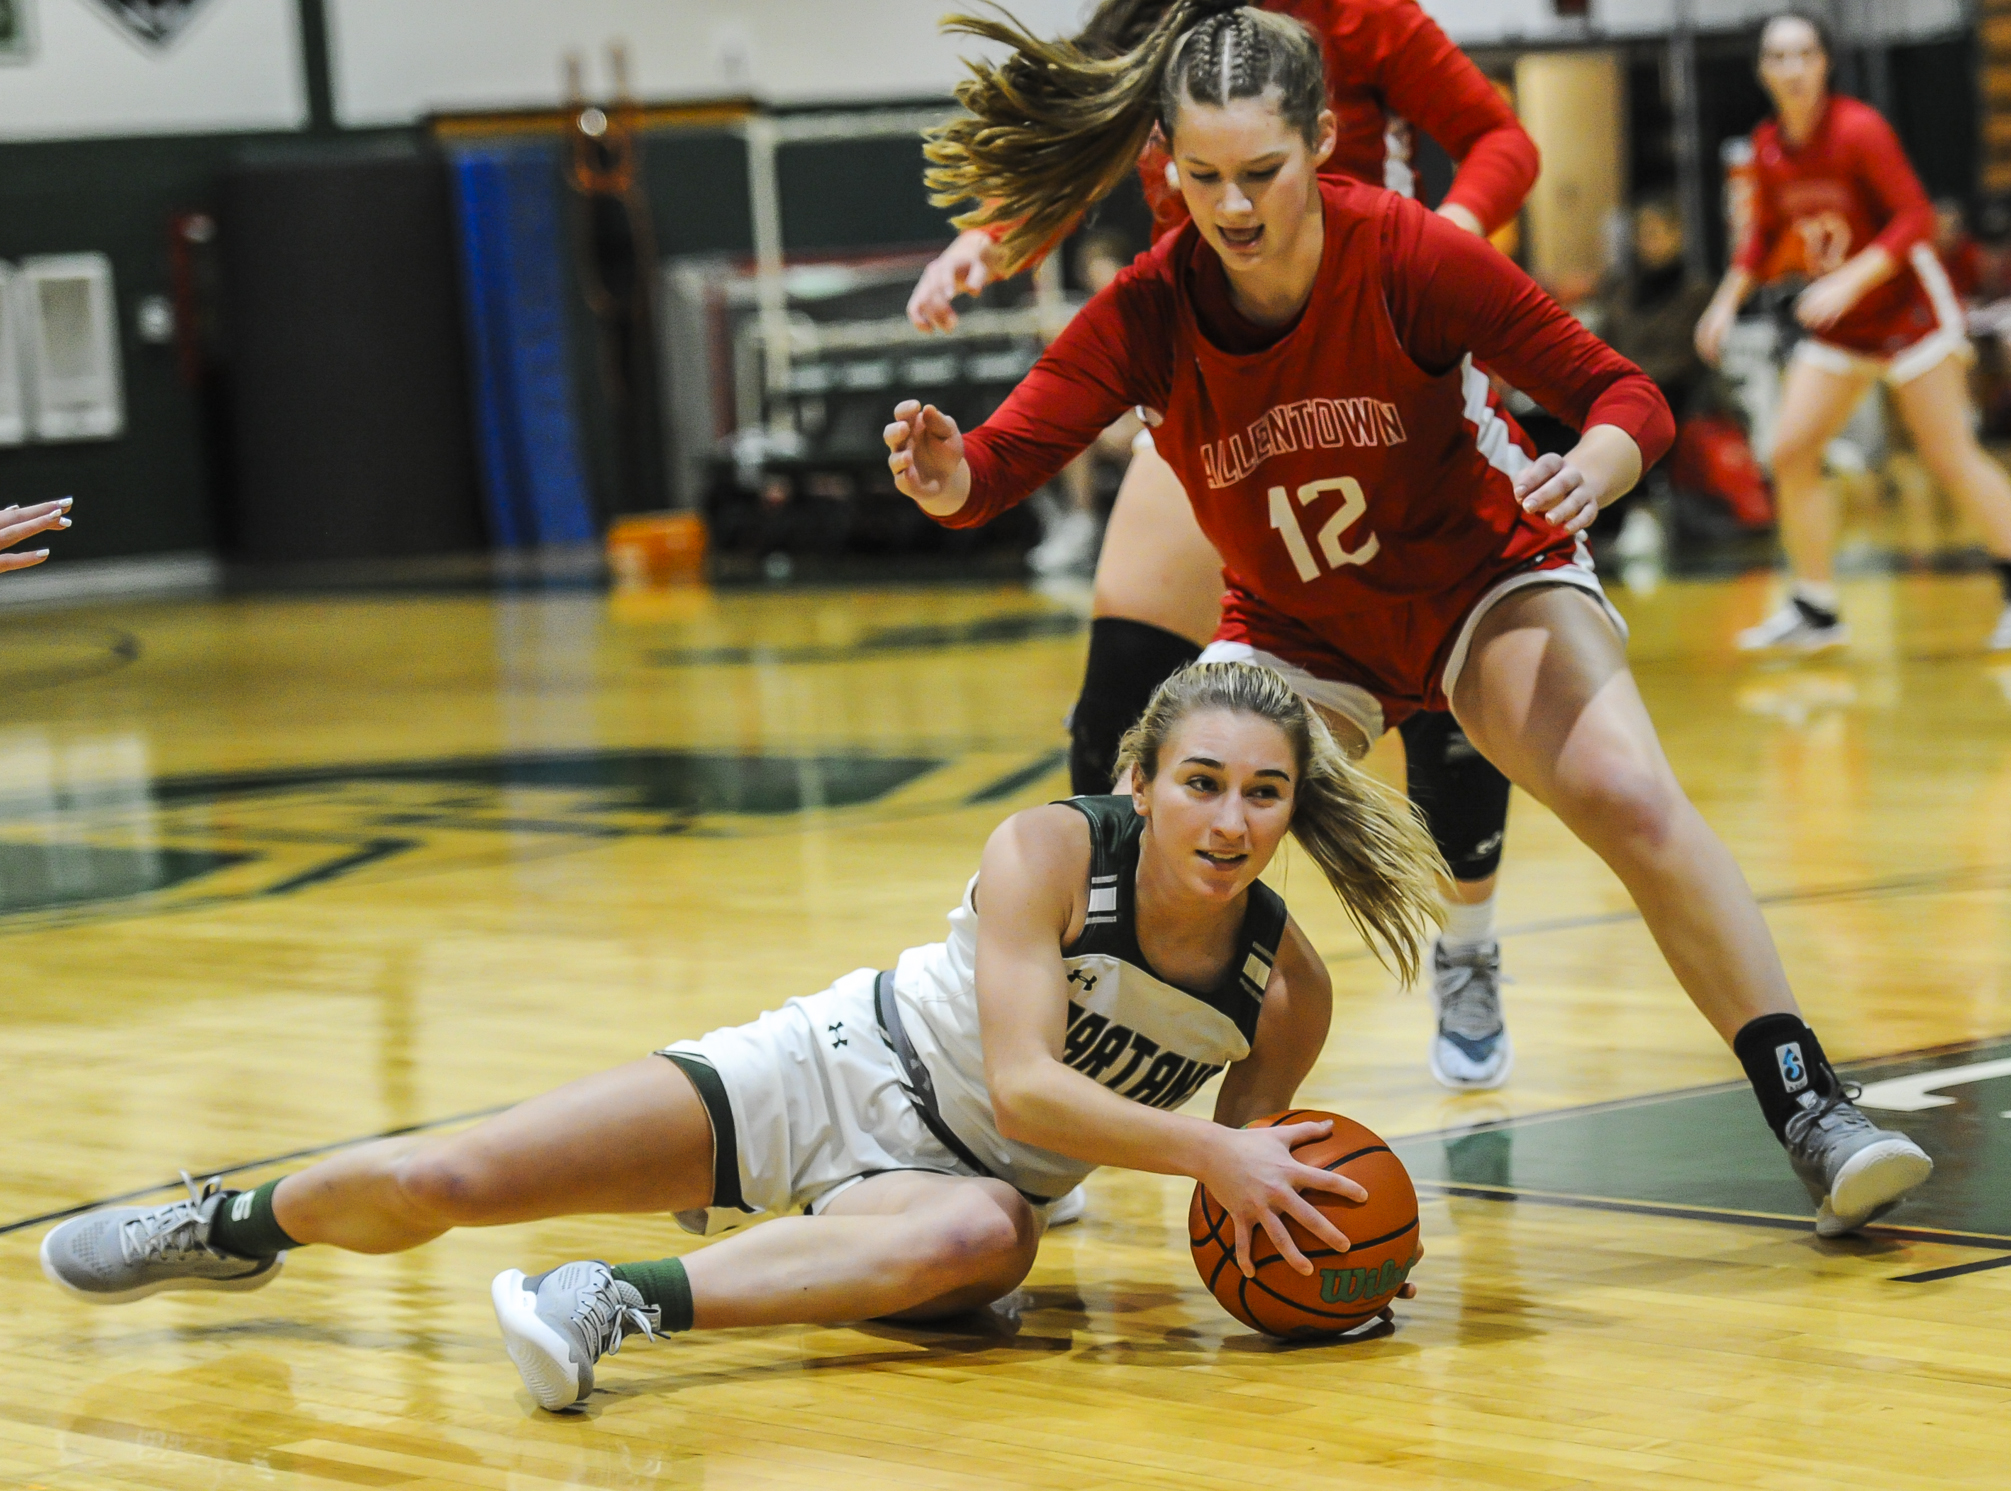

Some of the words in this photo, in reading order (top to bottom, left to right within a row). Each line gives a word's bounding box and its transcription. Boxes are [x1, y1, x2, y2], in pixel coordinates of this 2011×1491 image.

[1200, 397, 1407, 490] ALLENTOWN
[1267, 475, 1381, 584] 12
[1062, 999, 1225, 1111] ARTAN
